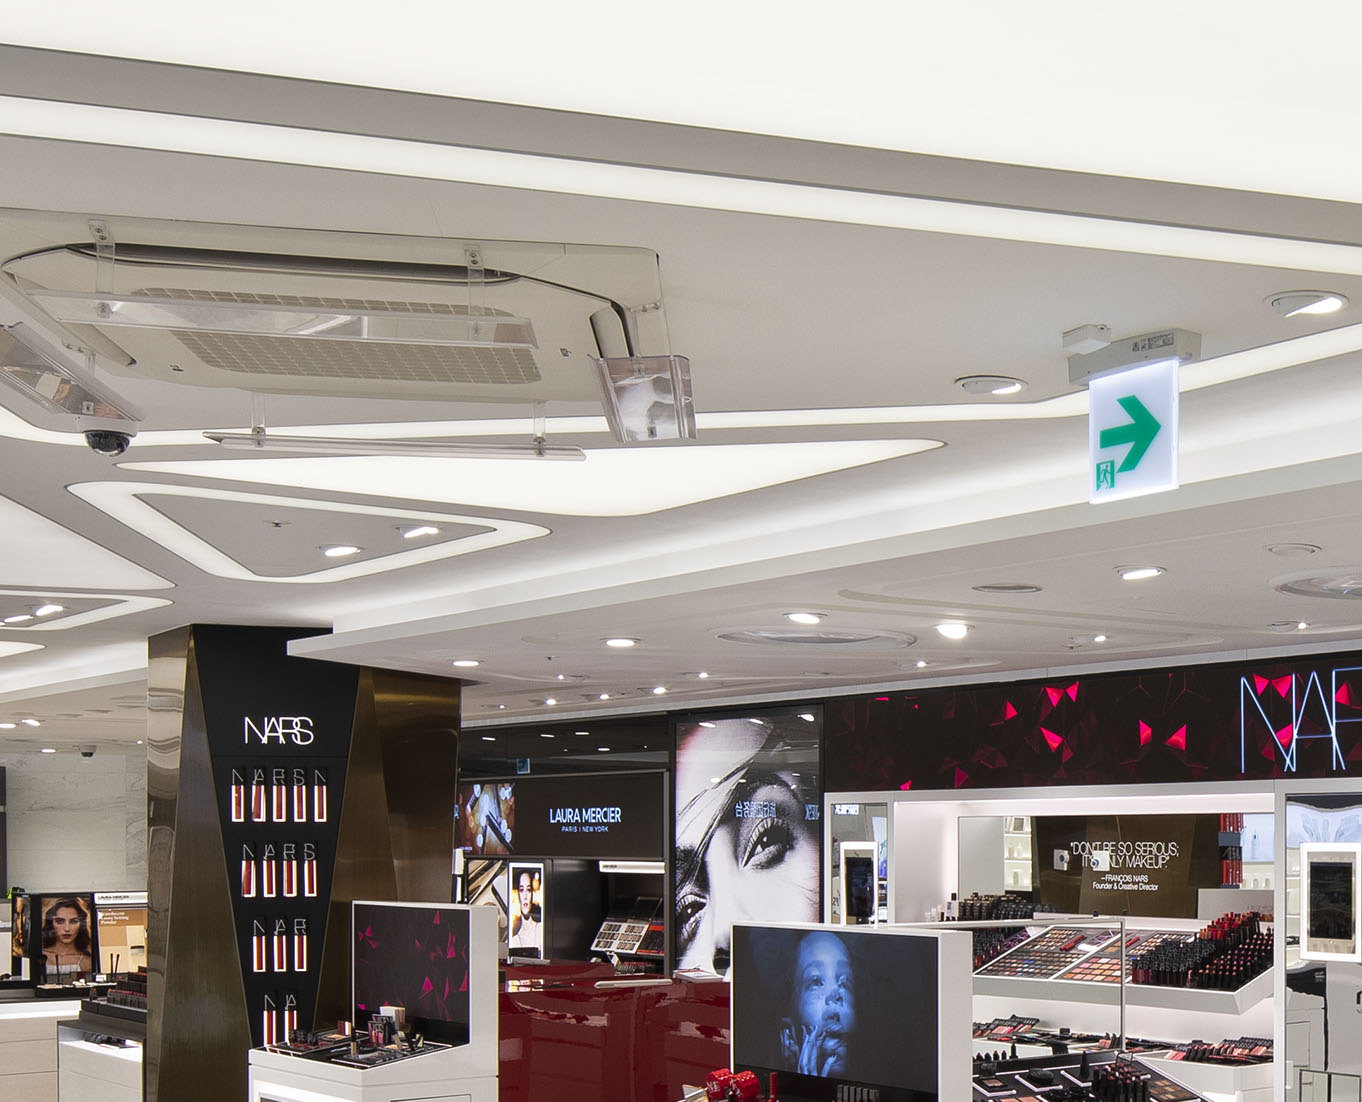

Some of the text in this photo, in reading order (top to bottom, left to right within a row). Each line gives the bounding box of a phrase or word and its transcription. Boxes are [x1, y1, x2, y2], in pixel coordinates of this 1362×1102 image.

[244, 716, 314, 745] NARS
[549, 807, 622, 823] LAURA MERCIER
[1118, 842, 1132, 855] SO
[1139, 882, 1158, 890] Director
